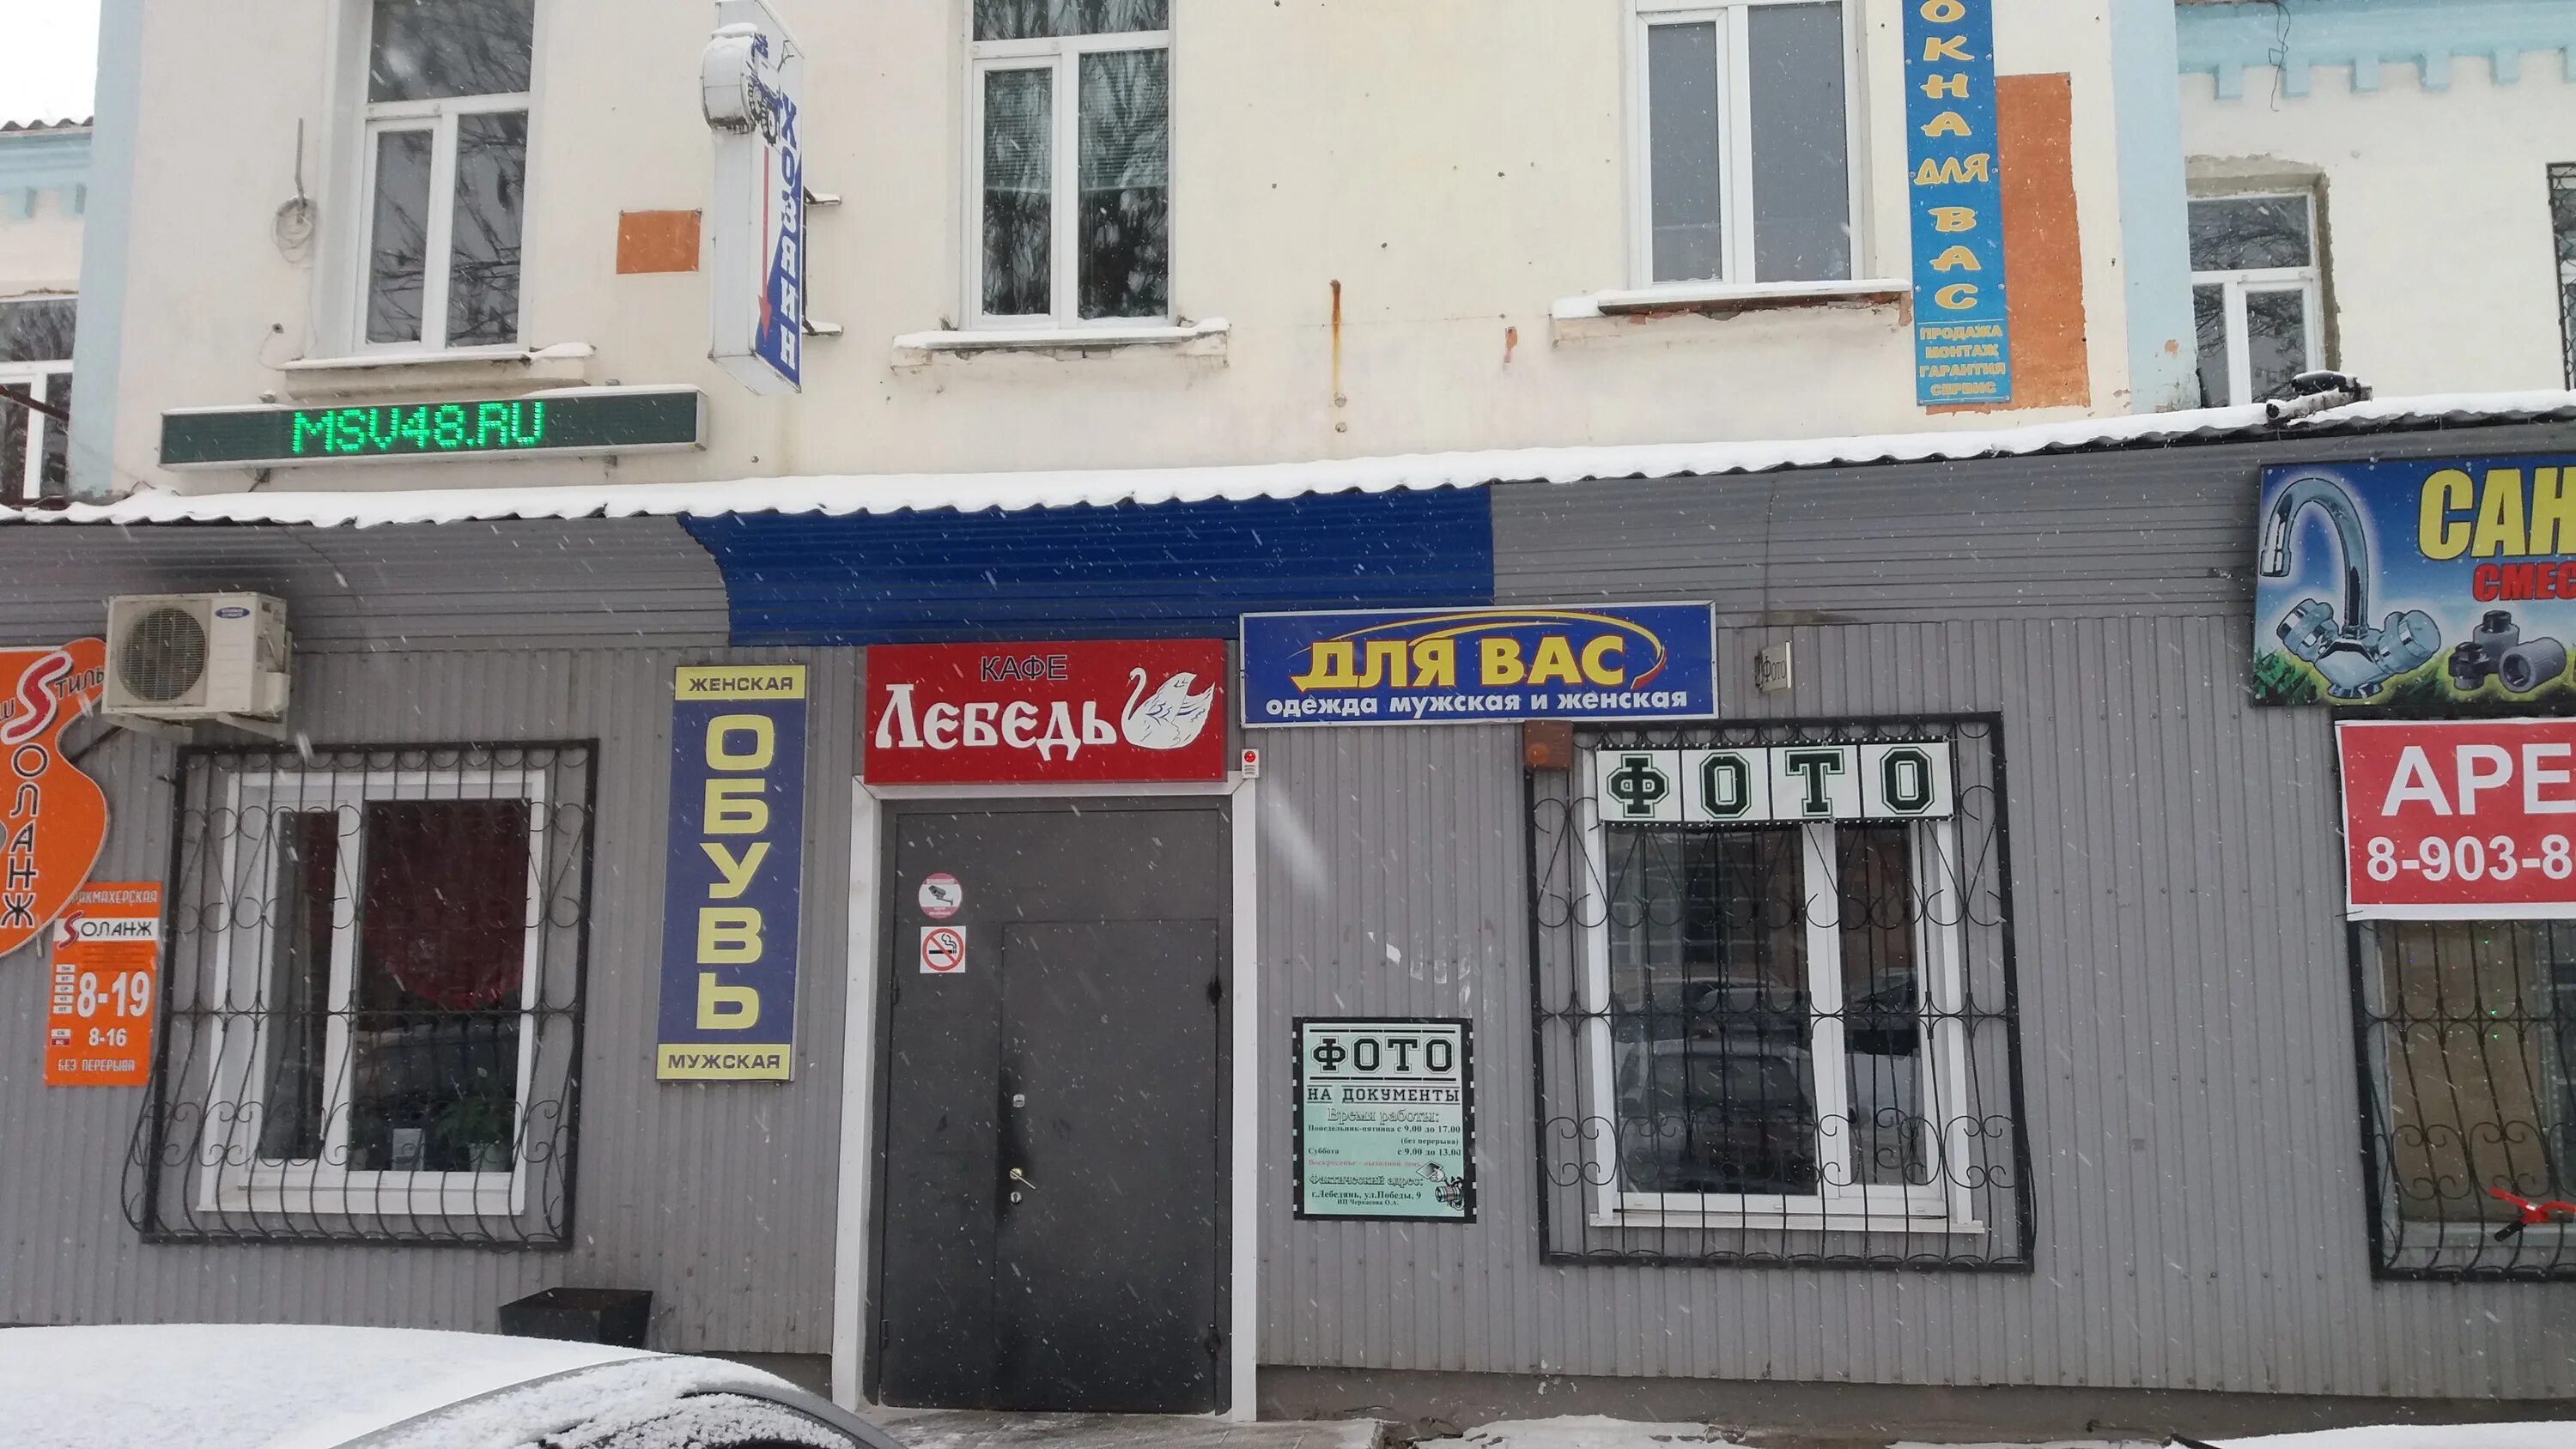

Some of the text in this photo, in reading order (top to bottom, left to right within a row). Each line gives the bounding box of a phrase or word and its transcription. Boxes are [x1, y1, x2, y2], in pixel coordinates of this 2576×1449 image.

[1920, 0, 1975, 136] ОКНА
[1913, 154, 1990, 185] ДЛЯ
[1929, 206, 1981, 310] ВАС
[1920, 325, 2003, 341] ПРОДАЖА
[1926, 343, 1999, 359] МОНТАЖ
[1919, 362, 2006, 378] ГАРАНТИЯ
[1930, 381, 1996, 396] СЕРВИС
[291, 400, 545, 454] MSV48.RU
[980, 654, 1067, 682] КАФЕ
[1291, 634, 1625, 692] ДЛЯ ВАС
[689, 676, 793, 692] ЖЕНСКАЯ
[1266, 691, 1687, 718] одежда мужская и женская
[1607, 745, 1935, 819] ФОТО
[2367, 834, 2573, 882] 8-903-8
[696, 714, 775, 1030] ОБУВЬ
[76, 971, 150, 1017] 8-19
[88, 1028, 127, 1046] 8-16
[58, 1058, 136, 1072] БЕЗ ПЕРЕРЫВА
[668, 1054, 781, 1070] МУЖСКАЯ
[1310, 1036, 1455, 1074] ФОТО
[1308, 1088, 1460, 1103] НА ДОКУМЕНТЫ
[1327, 1107, 1440, 1125] Время работы:
[1404, 1125, 1422, 1133] 9.00
[1308, 1148, 1340, 1156] Суббота
